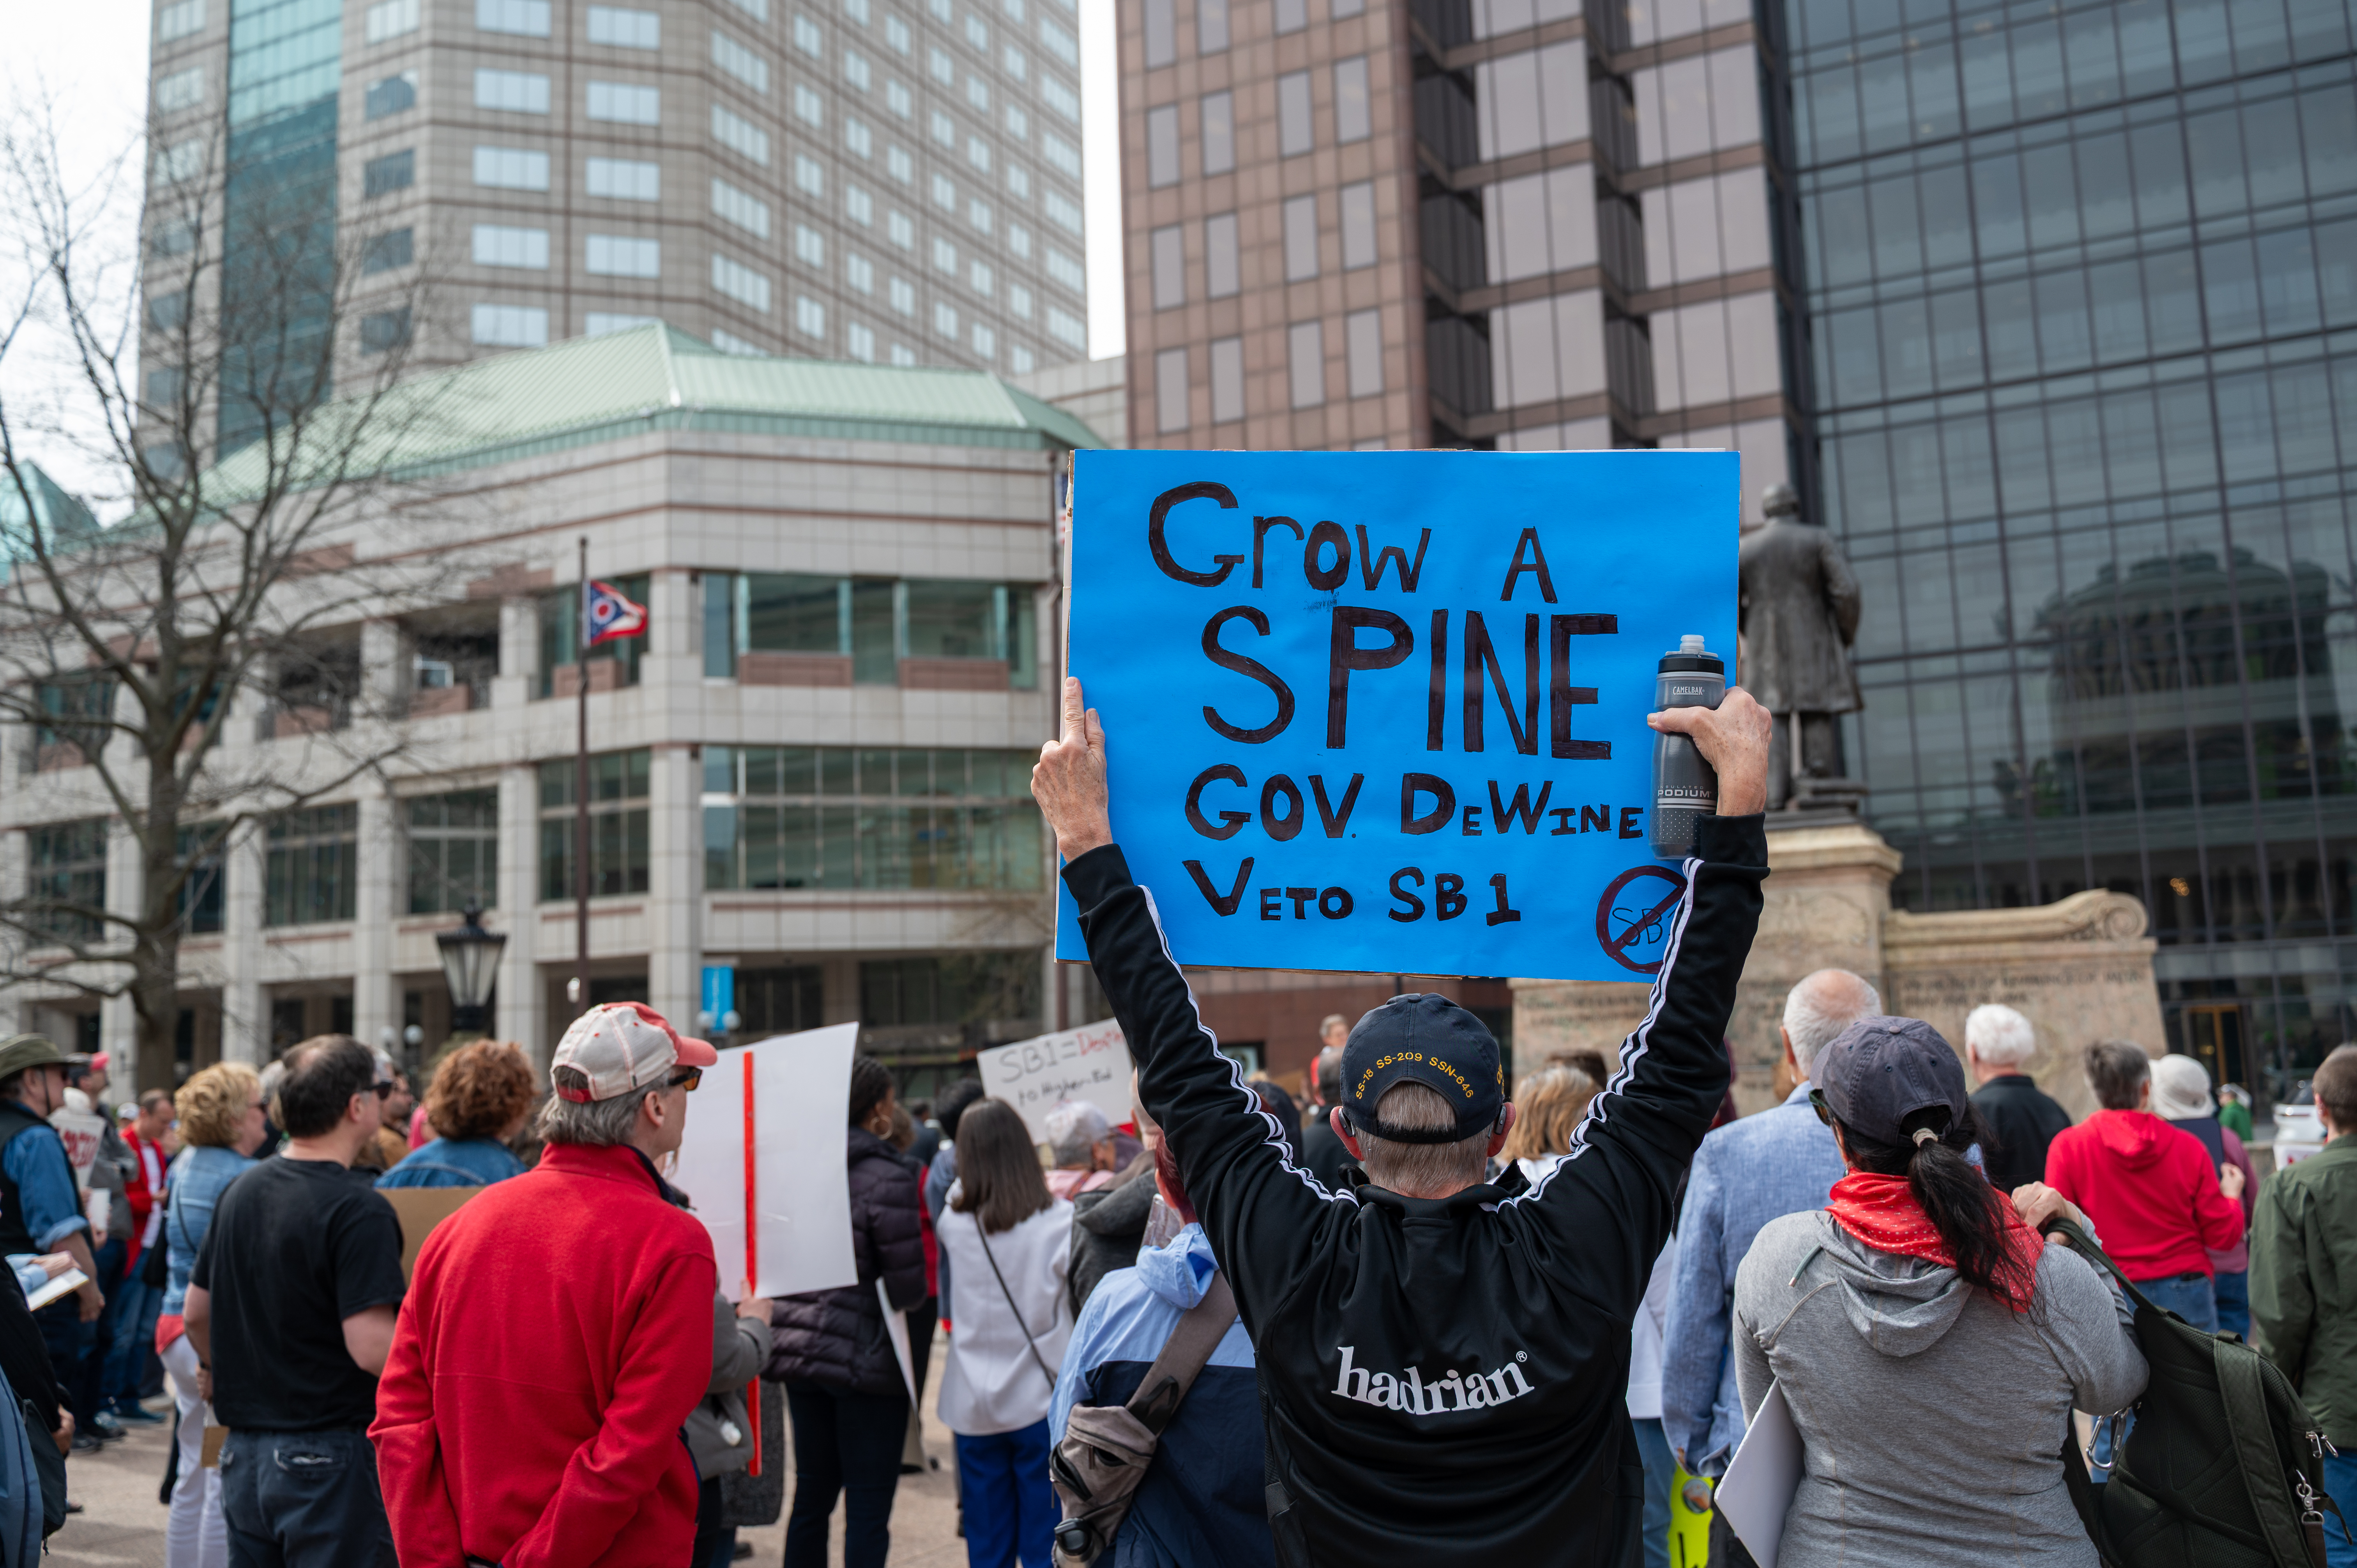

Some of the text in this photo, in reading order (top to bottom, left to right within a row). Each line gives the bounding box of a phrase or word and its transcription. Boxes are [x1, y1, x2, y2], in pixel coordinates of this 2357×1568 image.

[1500, 526, 1558, 604] A
[1201, 605, 1619, 760] SPINE
[1657, 789, 1710, 798] PODIUM
[1612, 907, 1677, 947] SB
[1356, 1069, 1373, 1099] SS-18
[1376, 1052, 1422, 1068] SS-209
[1429, 1057, 1474, 1098] SSN-646
